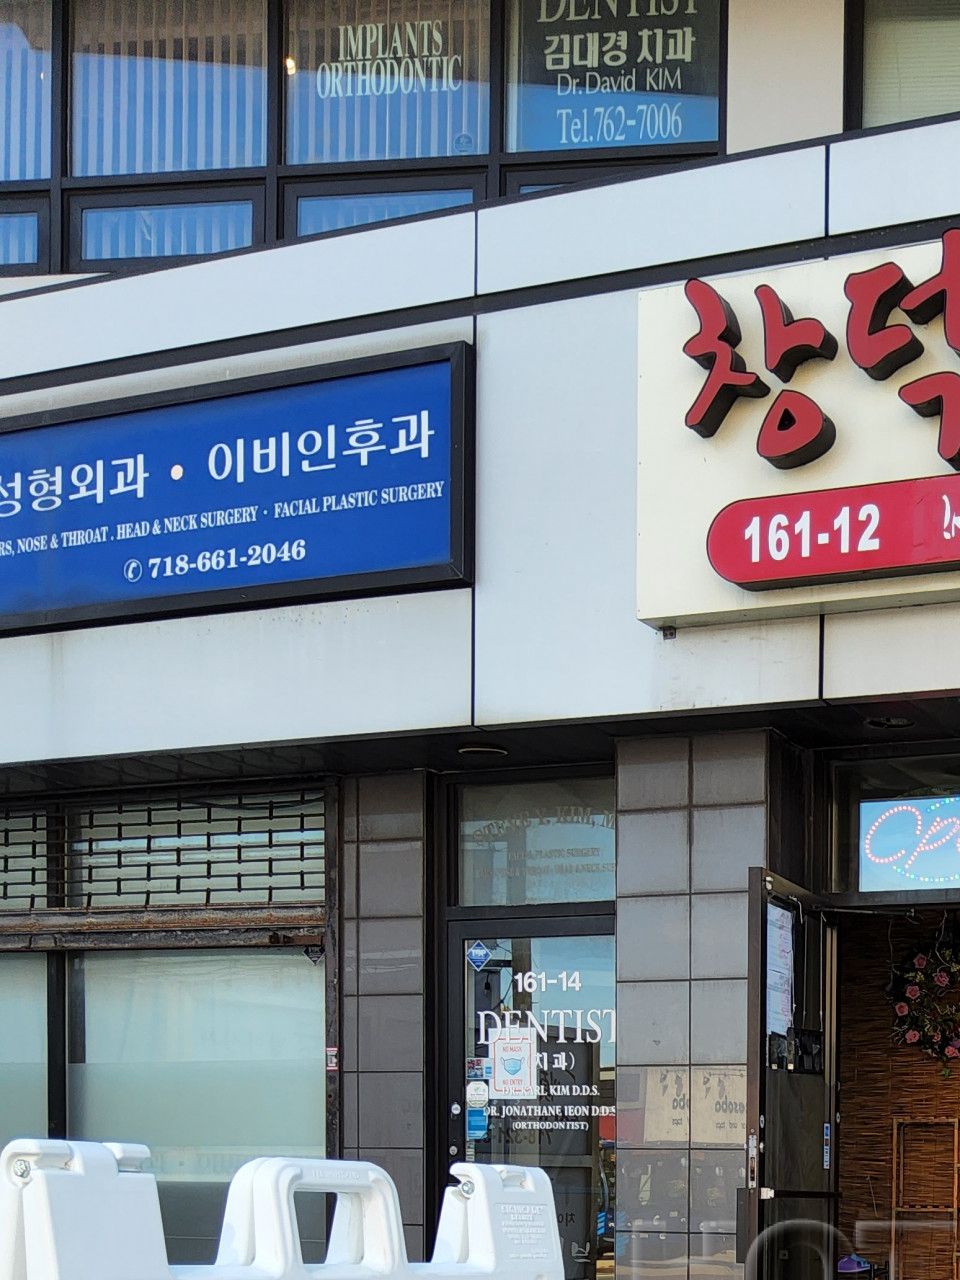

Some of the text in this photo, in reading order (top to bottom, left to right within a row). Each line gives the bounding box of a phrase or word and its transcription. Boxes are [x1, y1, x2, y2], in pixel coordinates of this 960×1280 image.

[338, 20, 443, 61] IMPLANTS
[544, 27, 696, 71] 김대경 치과
[316, 55, 462, 99] ORTHODONTIC
[645, 67, 682, 91] KIM
[208, 410, 435, 483] 이비인후과
[17, 535, 47, 554] NOSE
[50, 535, 59, 550] &
[61, 526, 109, 547] THROAT
[116, 521, 150, 540] HEAD
[152, 520, 161, 535] &
[164, 513, 198, 533] NECK
[200, 505, 258, 528] SURGERY
[274, 497, 319, 518] FACIAL
[323, 489, 378, 512] PLASTIC
[381, 480, 445, 505] SURGERY
[744, 503, 881, 563] 161-12
[148, 539, 306, 580] 718-661-2046
[514, 971, 582, 993] 161-14
[477, 1009, 616, 1044] DENTIST
[549, 1084, 570, 1096] KIM
[572, 1084, 600, 1096] D.D.S.
[483, 1105, 500, 1117] DR.
[501, 1105, 562, 1118] JONATHANE
[512, 1121, 590, 1132] (ORTHODONTIST)
